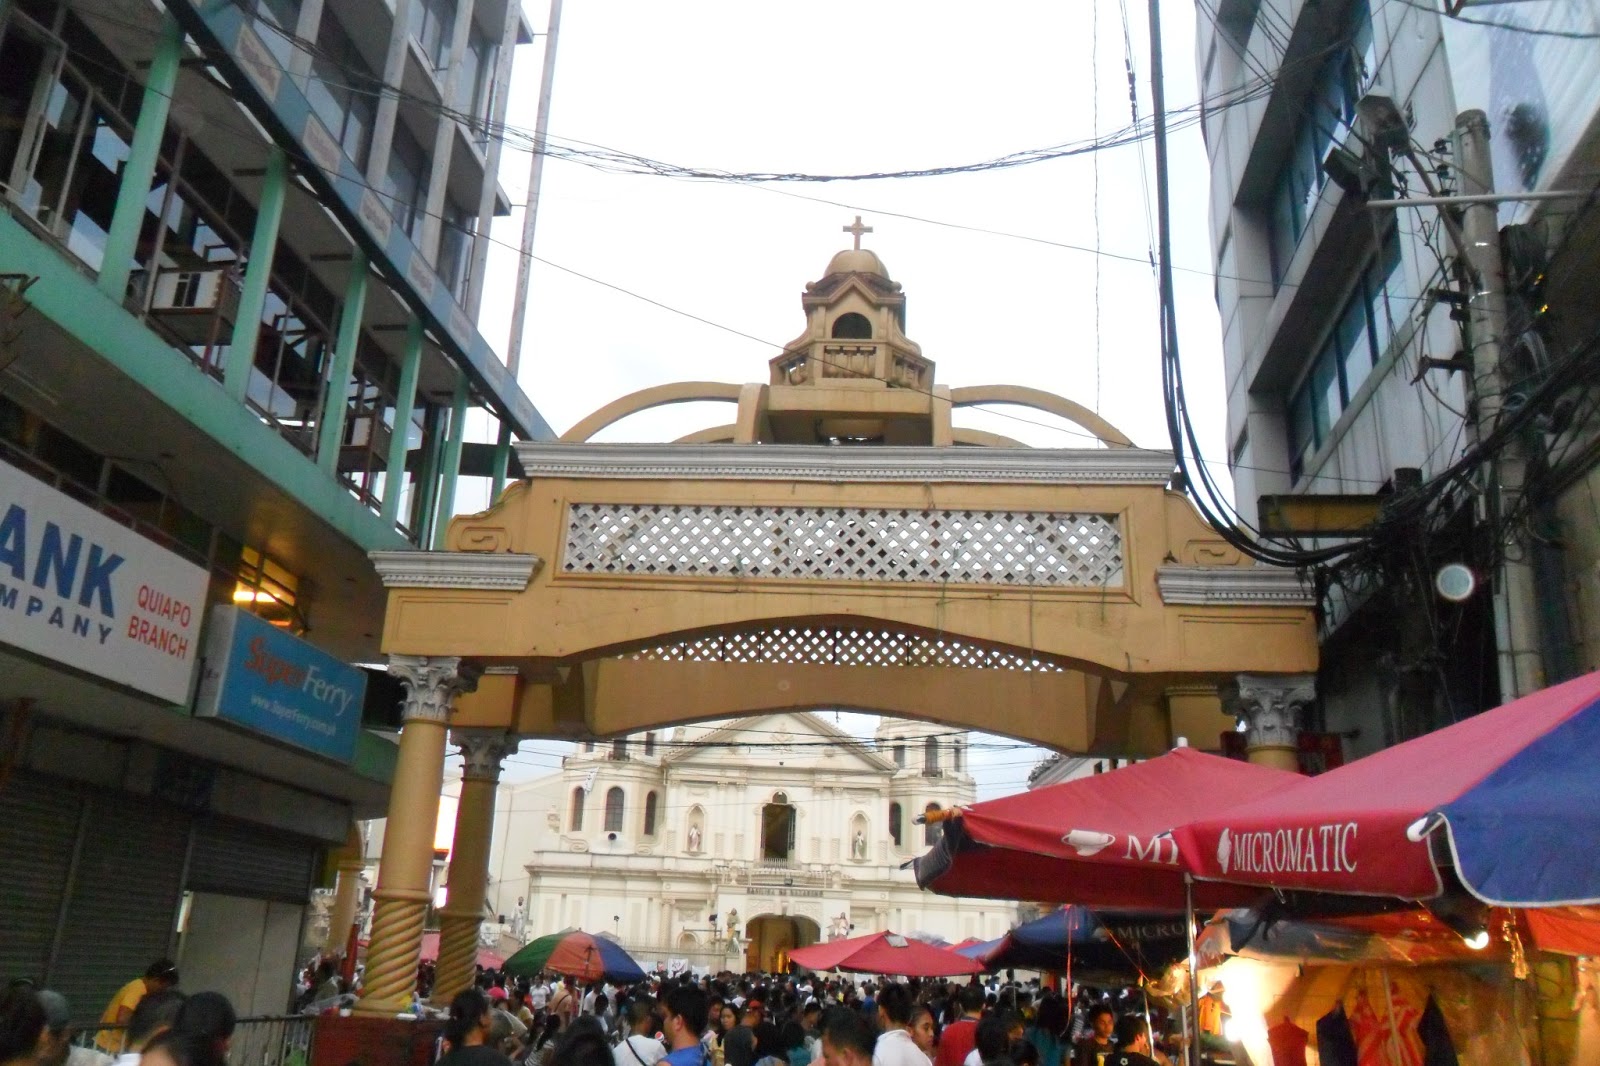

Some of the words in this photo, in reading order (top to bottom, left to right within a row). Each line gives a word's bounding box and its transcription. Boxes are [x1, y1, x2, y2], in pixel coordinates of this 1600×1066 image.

[0, 504, 125, 619] ANK
[138, 585, 191, 628] QUIAPO
[128, 616, 188, 659] BRANCH
[1233, 822, 1358, 873] MICROMATIC
